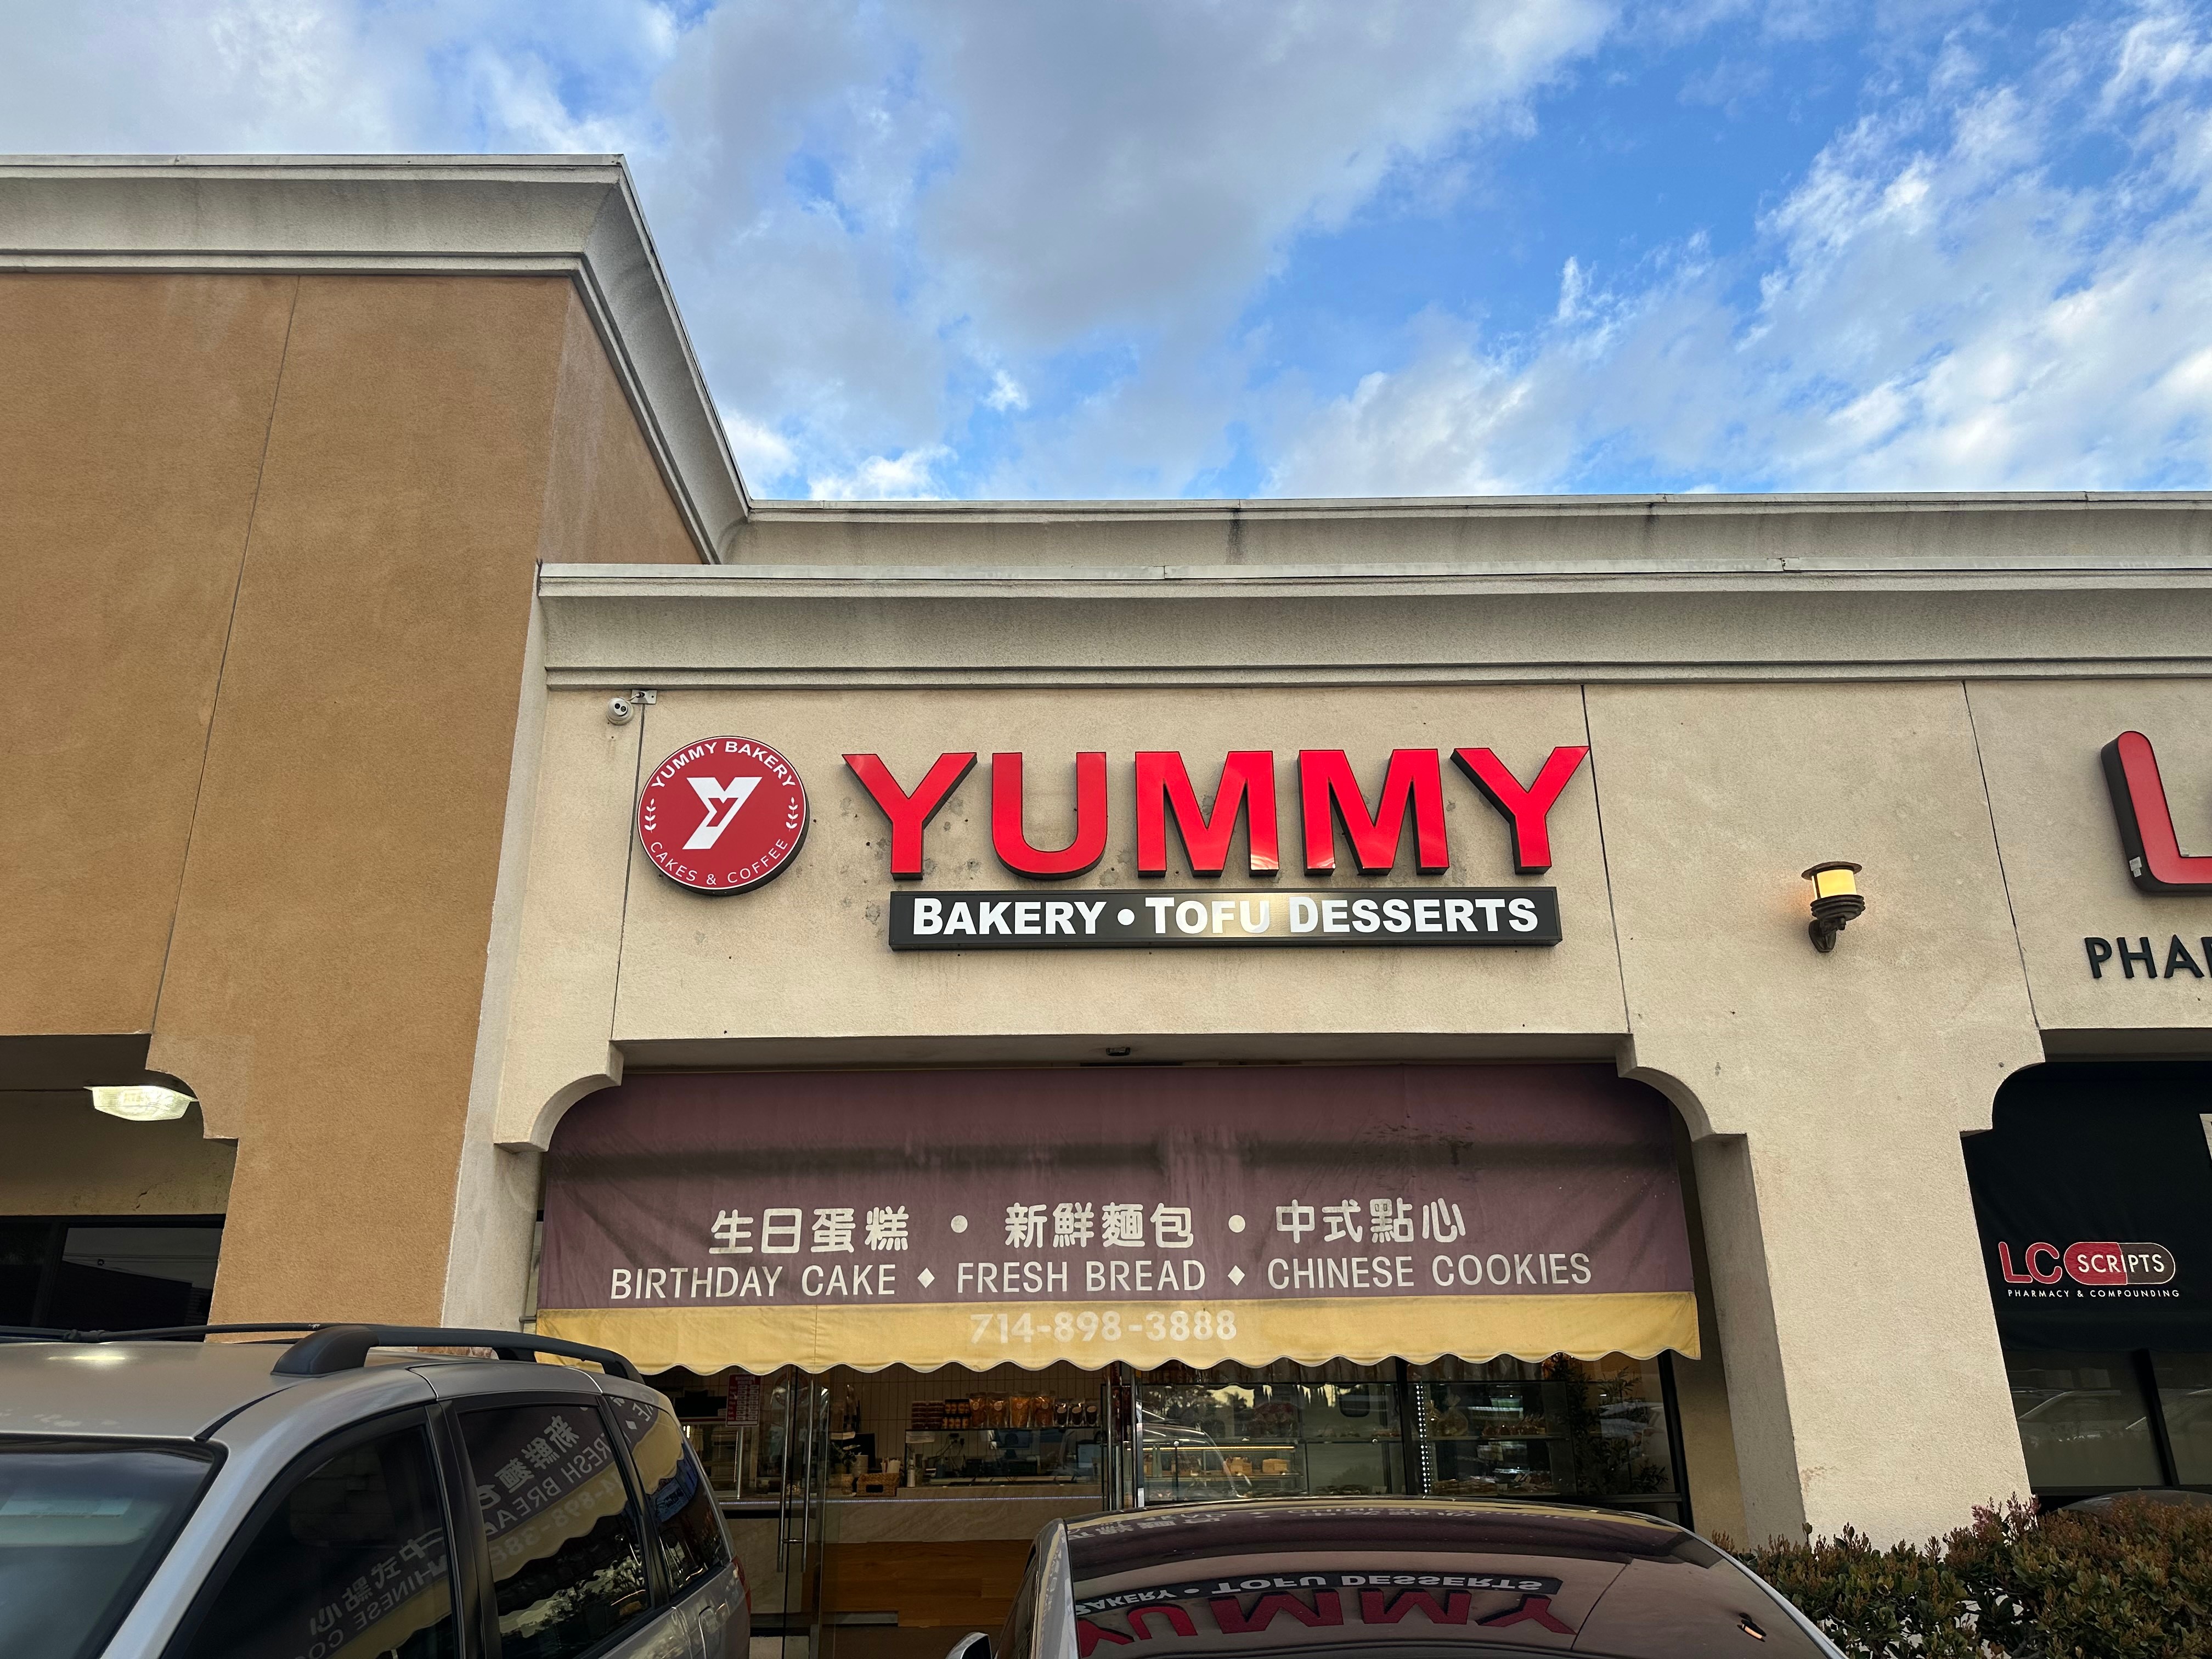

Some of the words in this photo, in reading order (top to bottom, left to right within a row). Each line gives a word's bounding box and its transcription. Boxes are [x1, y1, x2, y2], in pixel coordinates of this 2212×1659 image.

[651, 741, 717, 789] YUMMY
[725, 741, 796, 787] BAKERY
[843, 747, 1589, 878] YUMMY
[651, 841, 698, 882] CAKES
[706, 873, 717, 885] &
[727, 838, 788, 884] COFFEE
[913, 898, 1107, 935] BAKERY
[1145, 897, 1271, 934] TOFU
[1289, 895, 1538, 933] DESSERTS
[708, 1205, 910, 1255] 生日蛋糕
[1005, 1201, 1194, 1249] 新鮮麵包
[1276, 1197, 1466, 1244] 中式點心
[611, 1265, 783, 1300] BIRTHDAY
[802, 1264, 896, 1296] CAKE
[957, 1261, 1068, 1294] FRESH
[1086, 1259, 1206, 1293] BREAD
[1267, 1255, 1415, 1290] CHINESE
[1431, 1252, 1593, 1287] COOKIES
[1998, 1241, 2063, 1284] LC
[2076, 1253, 2165, 1274] SCRIPTS
[2007, 1289, 2069, 1298] PHARMACY
[2090, 1289, 2180, 1298] COMPOUNDING
[970, 1310, 1237, 1344] 714-898-3888
